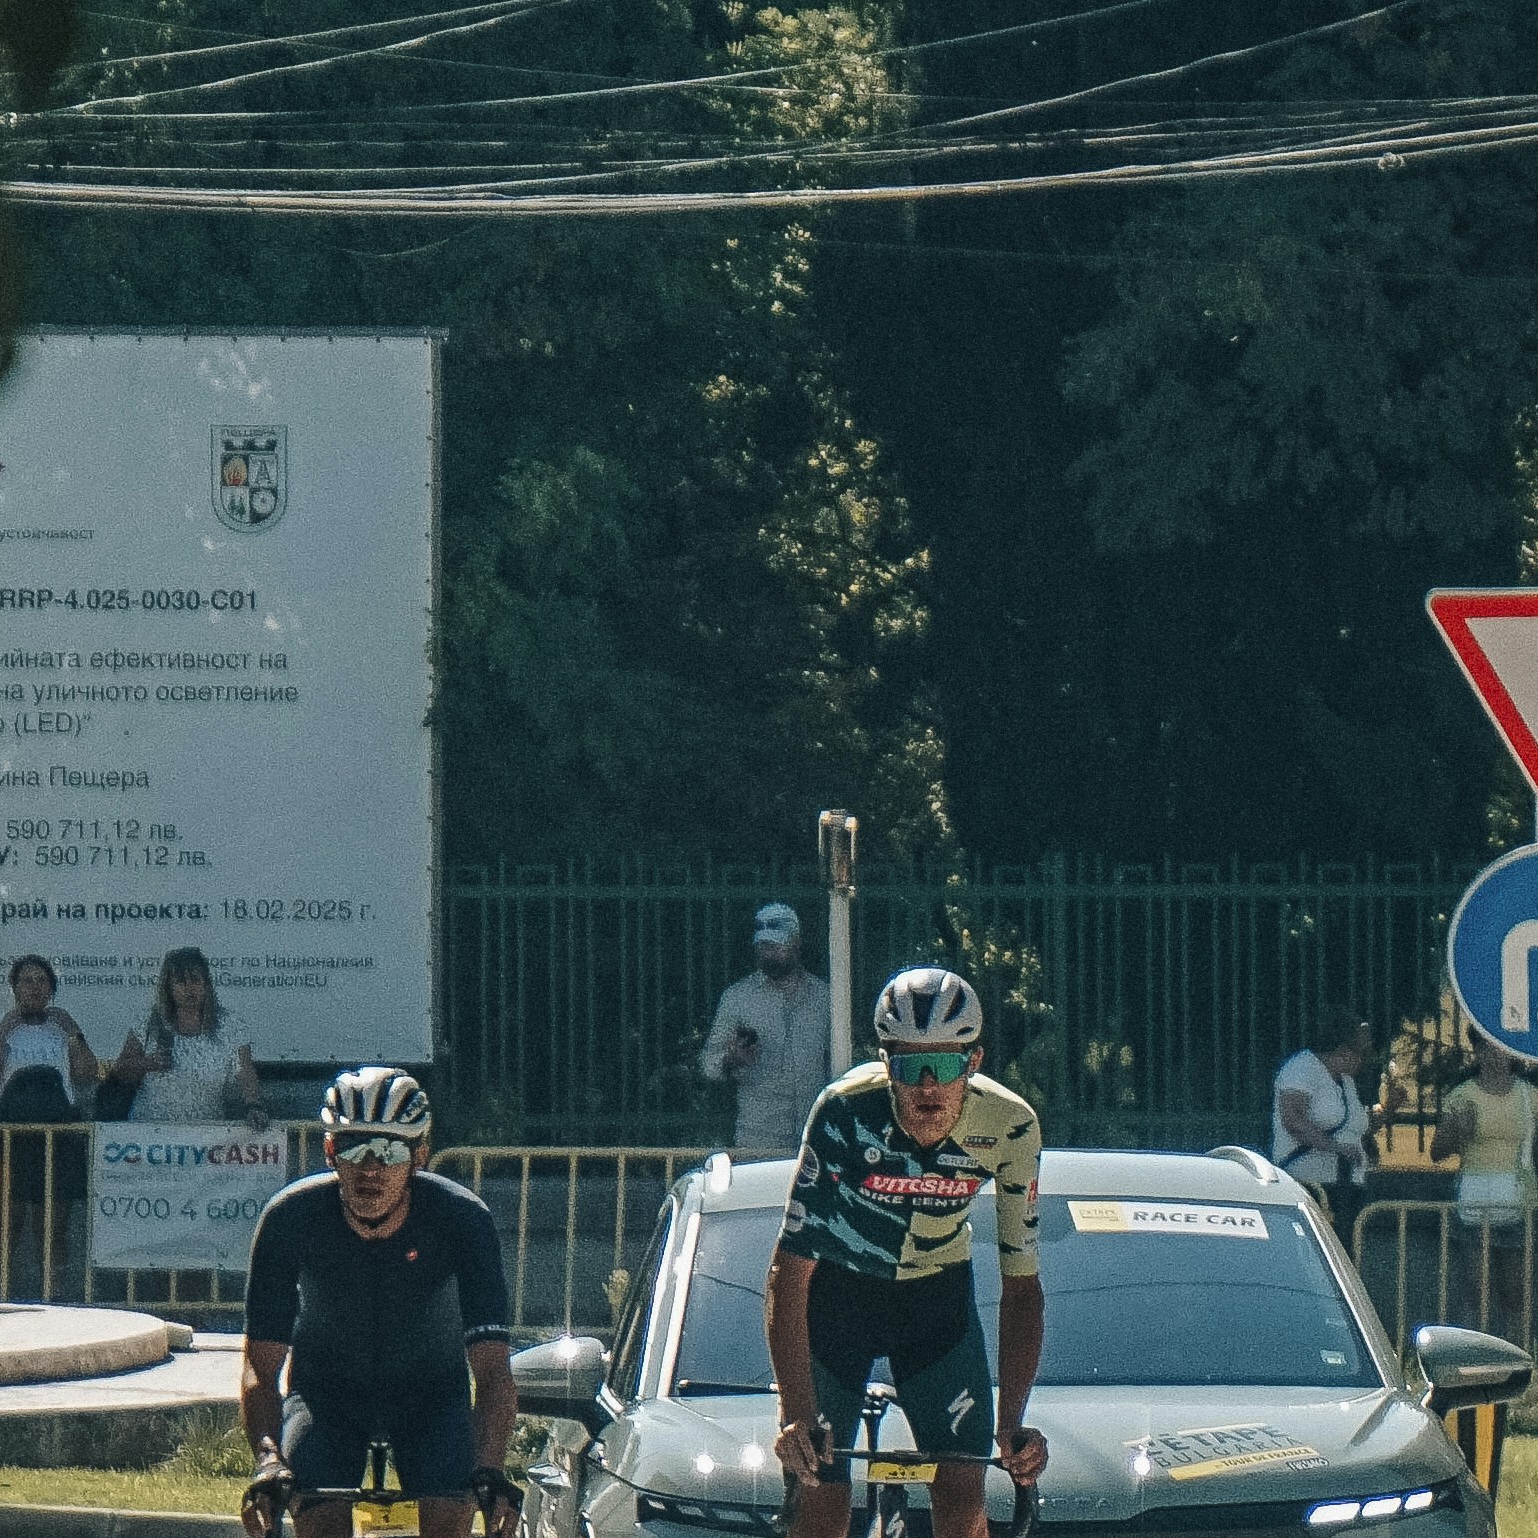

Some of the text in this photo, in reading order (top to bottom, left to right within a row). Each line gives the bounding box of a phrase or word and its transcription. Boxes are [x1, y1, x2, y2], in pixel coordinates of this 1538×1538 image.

[90, 647, 249, 674] ефективност
[259, 652, 288, 670] на
[32, 683, 149, 707] уличното
[155, 683, 300, 703] осветление
[49, 766, 150, 792] Пещера
[6, 819, 51, 840] 590
[59, 819, 141, 844] 711,12
[149, 822, 184, 841] лв.
[34, 845, 80, 867] 590
[89, 845, 170, 870] 711,12
[57, 903, 87, 920] на
[94, 902, 210, 925] проекта:
[146, 1141, 280, 1167] CITYCASH
[873, 1175, 969, 1196] VITOSHA
[100, 1197, 266, 1221] 0700 4 600
[1132, 1210, 1199, 1224] RACE
[1205, 1213, 1257, 1228] CAR
